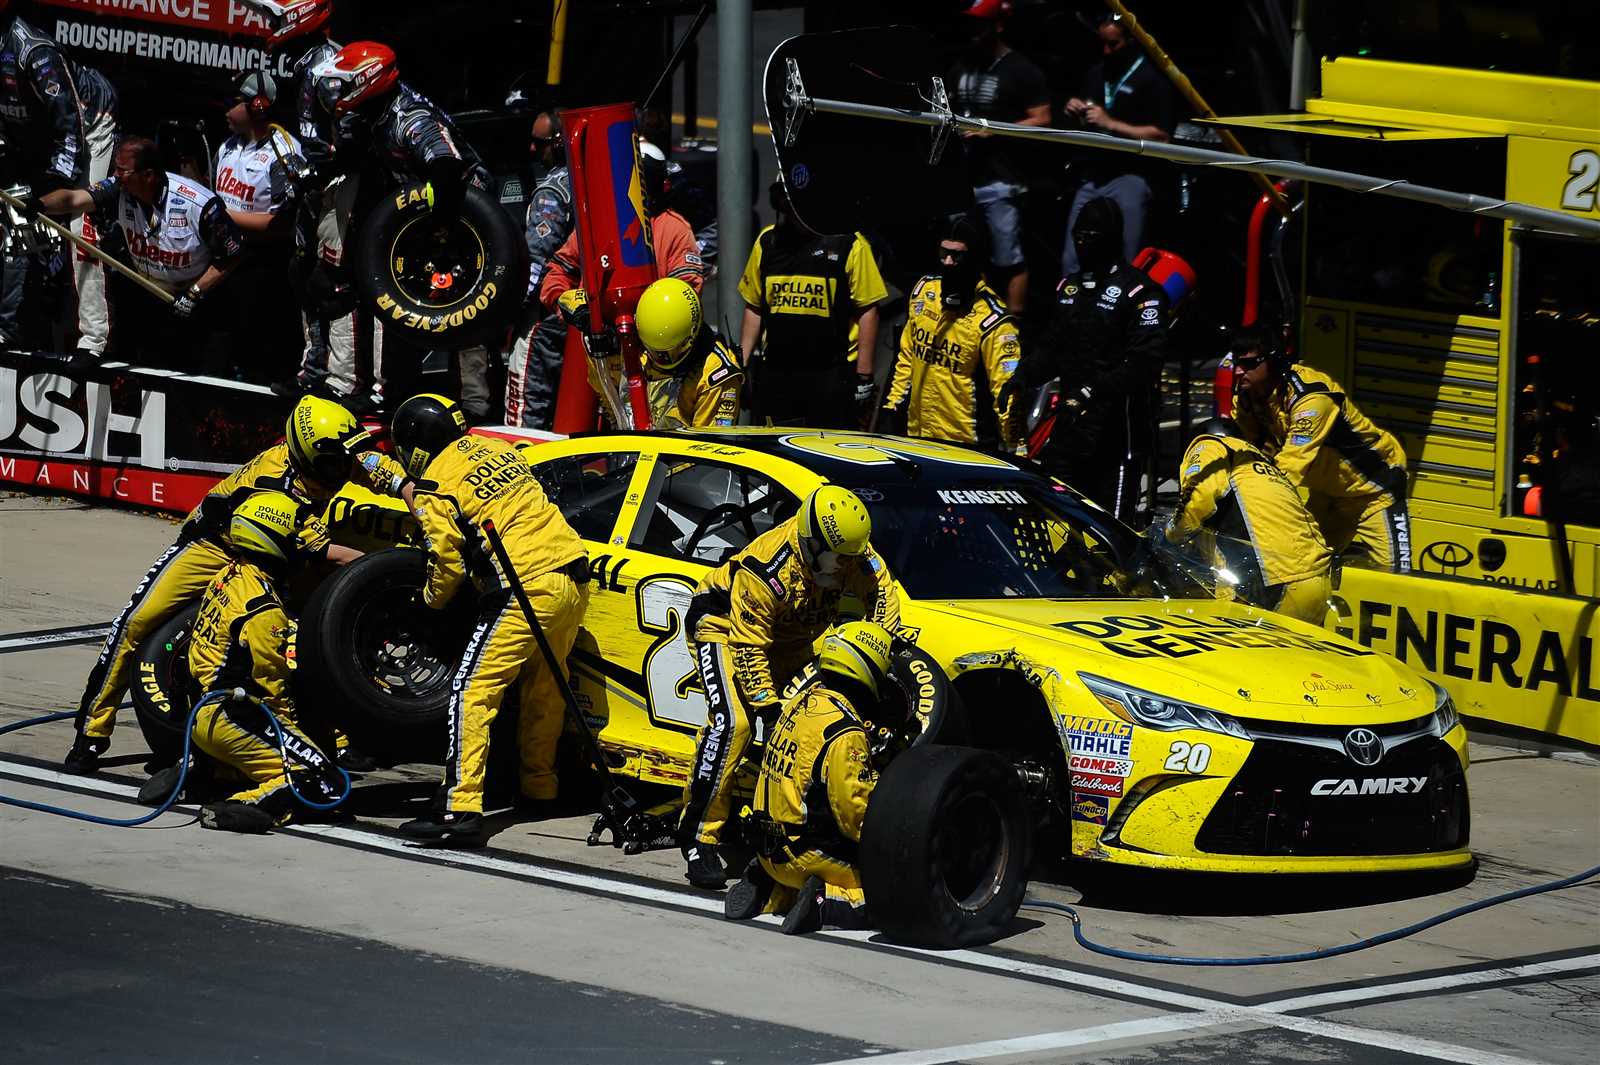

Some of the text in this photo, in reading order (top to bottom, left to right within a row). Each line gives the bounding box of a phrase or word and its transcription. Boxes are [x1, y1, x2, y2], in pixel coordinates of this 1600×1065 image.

[56, 20, 293, 78] ROUSHPERFORMANCE.C
[354, 75, 365, 87] 16
[1561, 148, 1600, 212] 2
[772, 282, 824, 296] DOLLAR
[772, 295, 826, 310] GENERAL
[298, 406, 310, 442] GENERAL
[305, 406, 316, 439] DOLLAR
[468, 446, 495, 463] TATE
[464, 451, 519, 487] DOLLAR
[474, 464, 531, 501] GENERAL
[936, 489, 1028, 505] KENSETH
[254, 510, 291, 530] GENERAL
[258, 505, 292, 521] DOLLAR
[821, 515, 840, 549] GENERAL
[827, 514, 846, 544] DOLLAR
[1050, 614, 1315, 639] DOLLAR
[855, 634, 888, 661] GENERAL
[859, 630, 888, 651] DOLLAR
[1100, 631, 1375, 658] GENERAL
[453, 622, 488, 691] GENERAL
[1327, 680, 1356, 693] Spice
[698, 643, 725, 779] DOLLAR GENERAL
[1063, 715, 1131, 736] MOOG
[1069, 735, 1130, 756] MAHLE
[1071, 757, 1116, 771] COMP
[1163, 741, 1212, 774] 20
[1072, 776, 1121, 793] Edelbrock
[1305, 777, 1428, 796] CAMRY
[1074, 804, 1106, 816] SUNOCO
